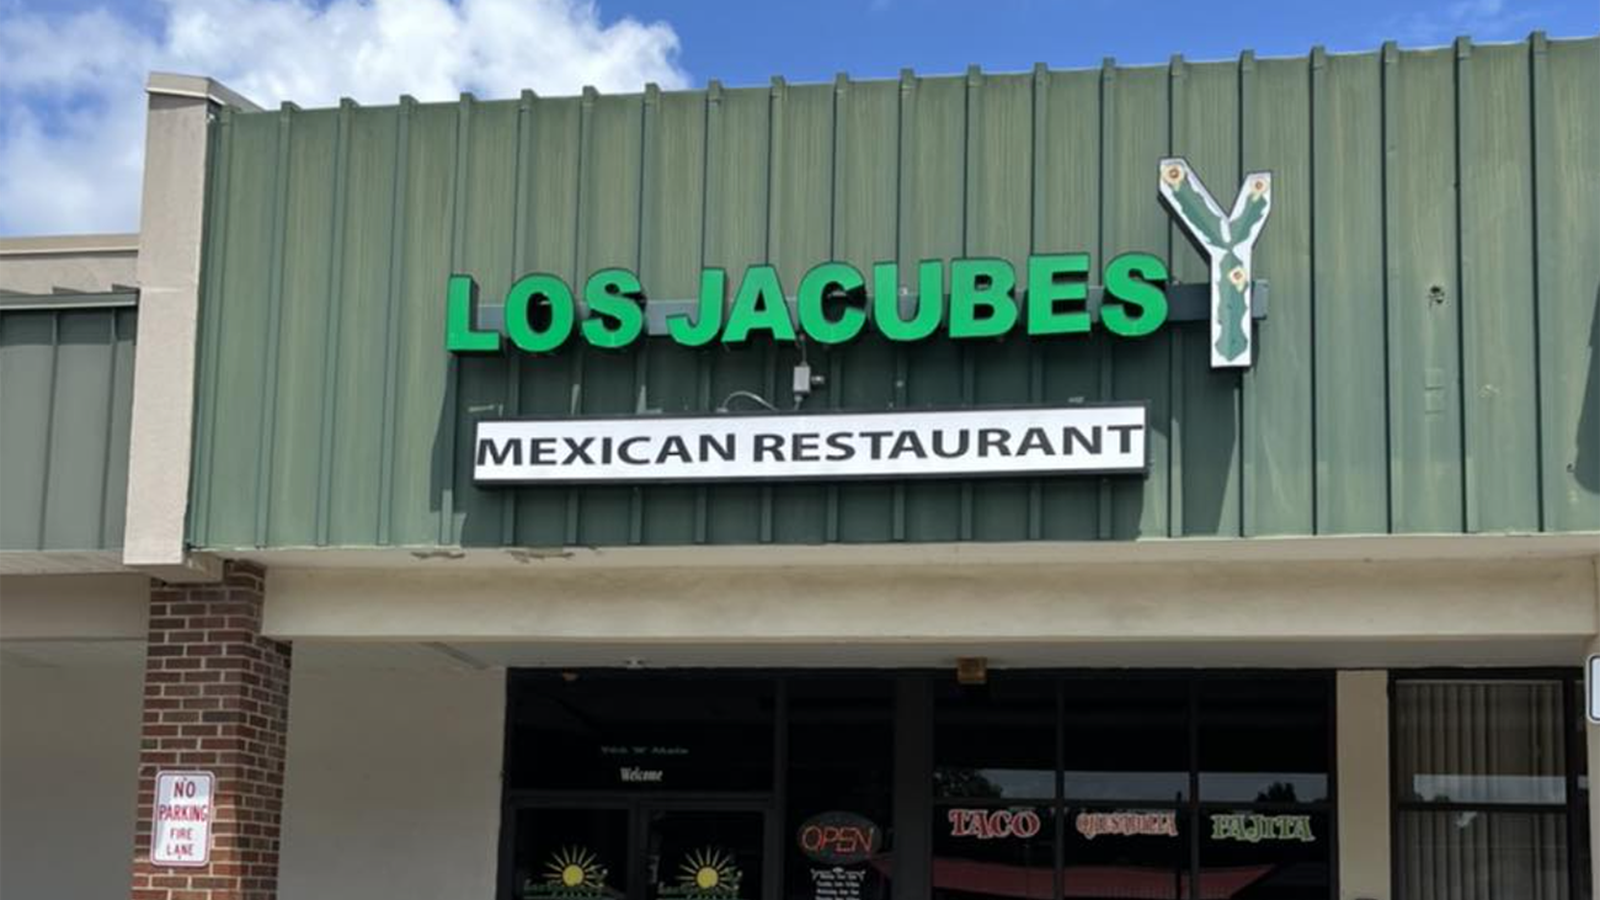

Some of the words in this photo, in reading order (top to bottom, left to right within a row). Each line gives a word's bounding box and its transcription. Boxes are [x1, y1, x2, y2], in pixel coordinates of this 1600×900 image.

[445, 269, 644, 354] LOS
[667, 252, 1170, 348] JACUBES
[476, 432, 737, 467] MEXICAN
[752, 424, 1144, 463] RESTAURANT
[620, 767, 663, 781] Welcome
[173, 780, 196, 798] NO
[158, 804, 209, 822] PARKING
[170, 827, 194, 841] FIRE
[948, 809, 1041, 839] TACO
[1211, 814, 1315, 842] FAJITA
[166, 843, 195, 856] LANE
[802, 827, 875, 851] OPEN
